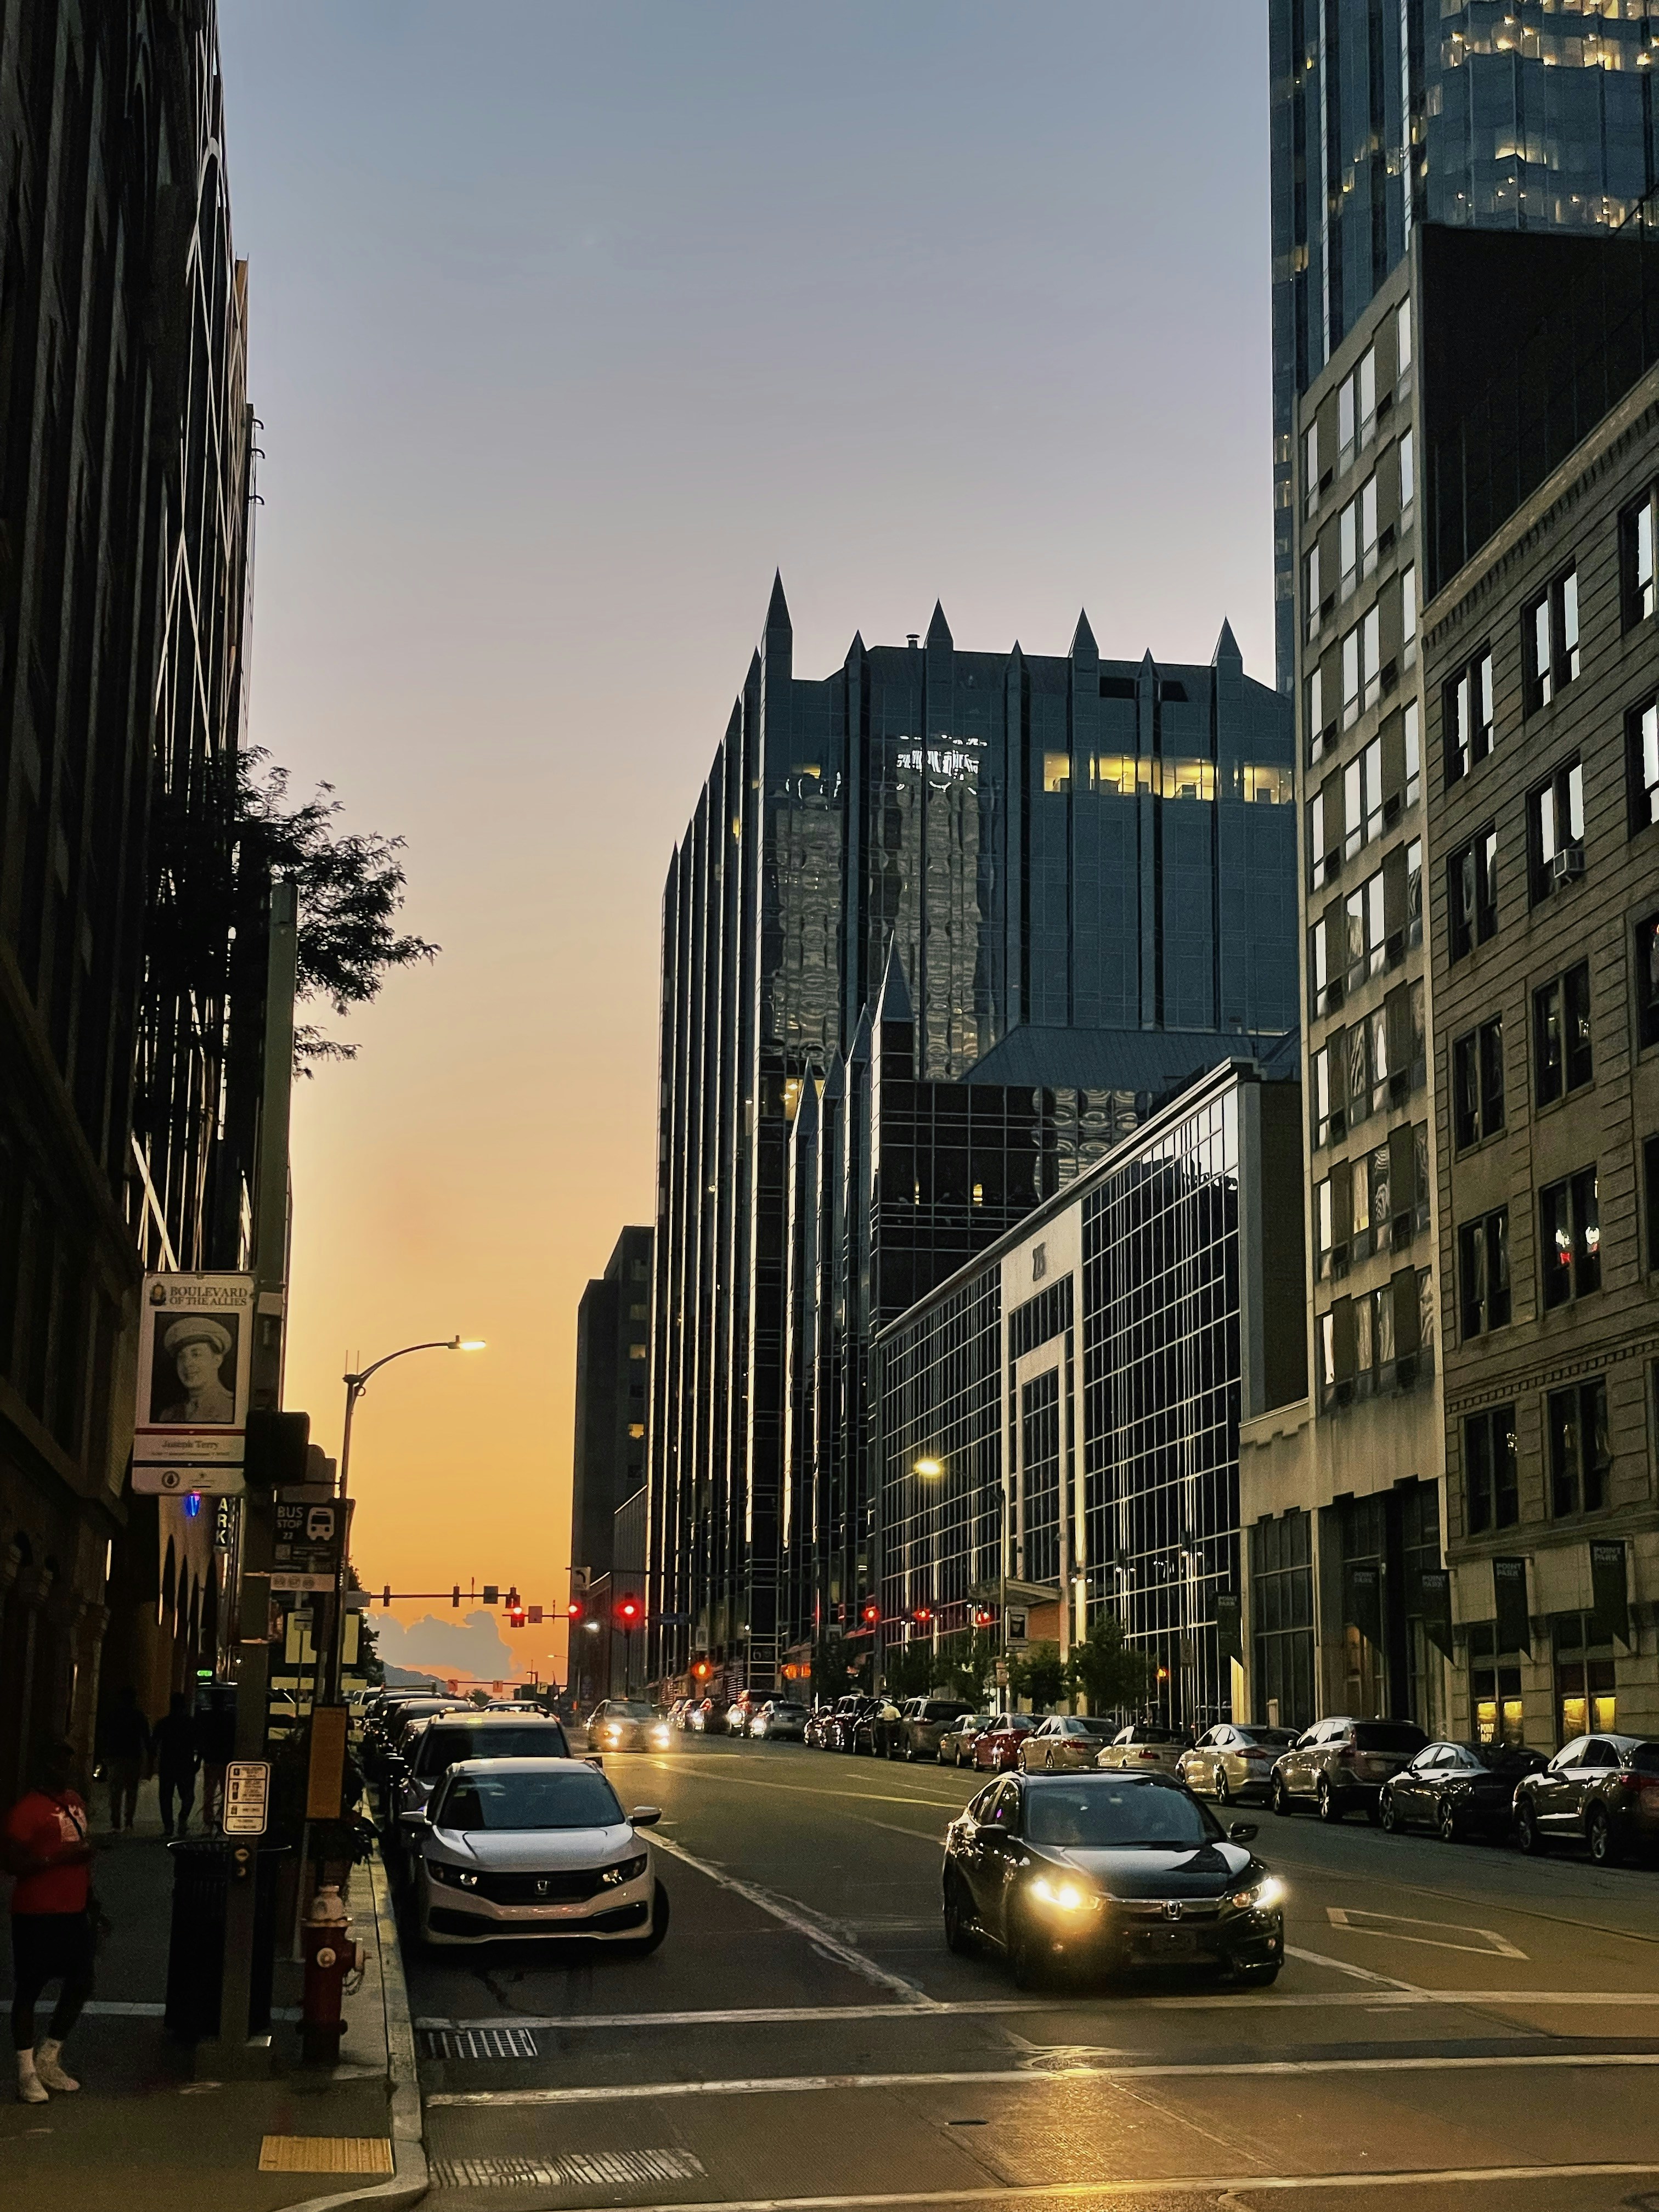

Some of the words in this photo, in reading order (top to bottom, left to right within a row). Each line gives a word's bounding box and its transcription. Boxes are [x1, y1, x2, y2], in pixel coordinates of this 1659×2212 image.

[171, 1286, 247, 1296] BOULEVARD
[211, 1297, 247, 1306] ALLIES
[277, 1506, 303, 1518] BUS
[276, 1519, 302, 1528] STOP
[1593, 1547, 1622, 1555] POINT
